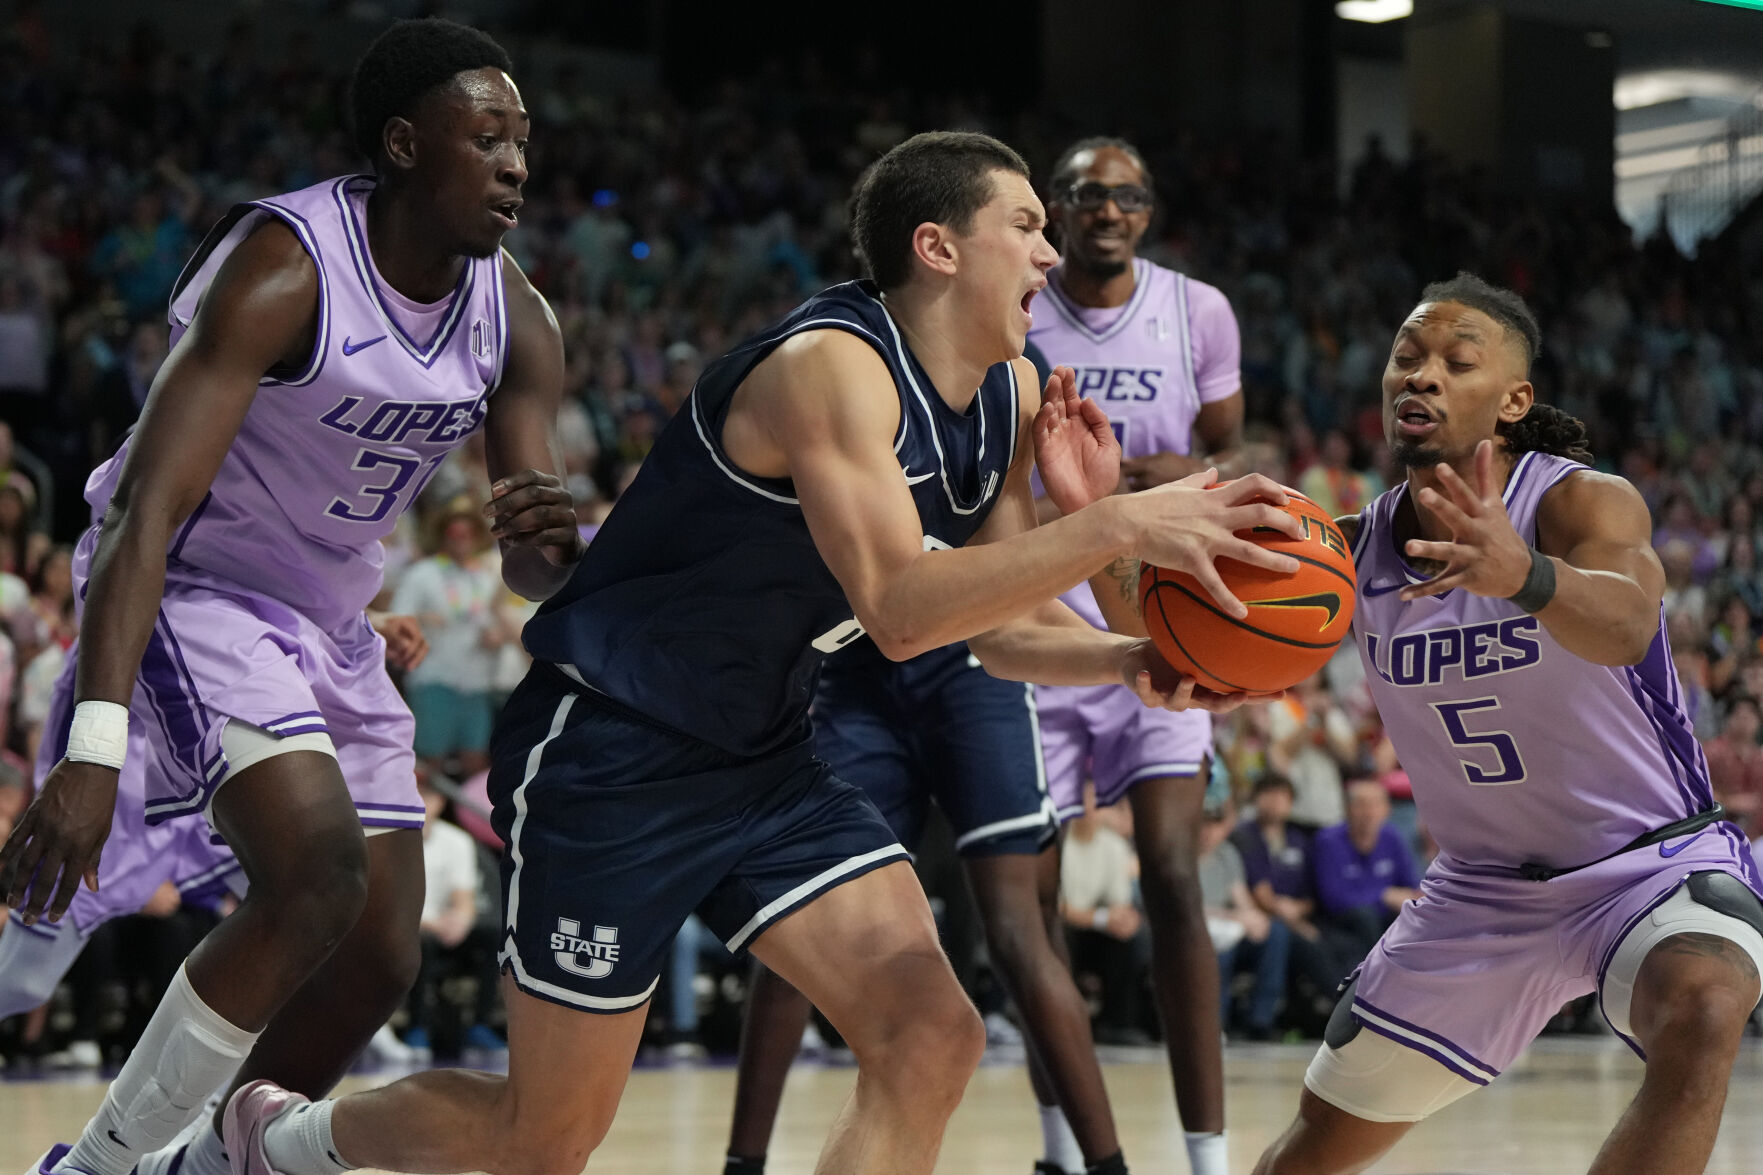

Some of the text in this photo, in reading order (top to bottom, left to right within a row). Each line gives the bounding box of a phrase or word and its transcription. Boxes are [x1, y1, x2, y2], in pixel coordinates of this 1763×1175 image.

[1072, 366, 1165, 402] PES
[318, 395, 488, 444] LOPES
[323, 447, 450, 523] 31
[1365, 614, 1542, 688] LOPES
[1427, 695, 1528, 786] 5
[551, 933, 620, 962] STATE
